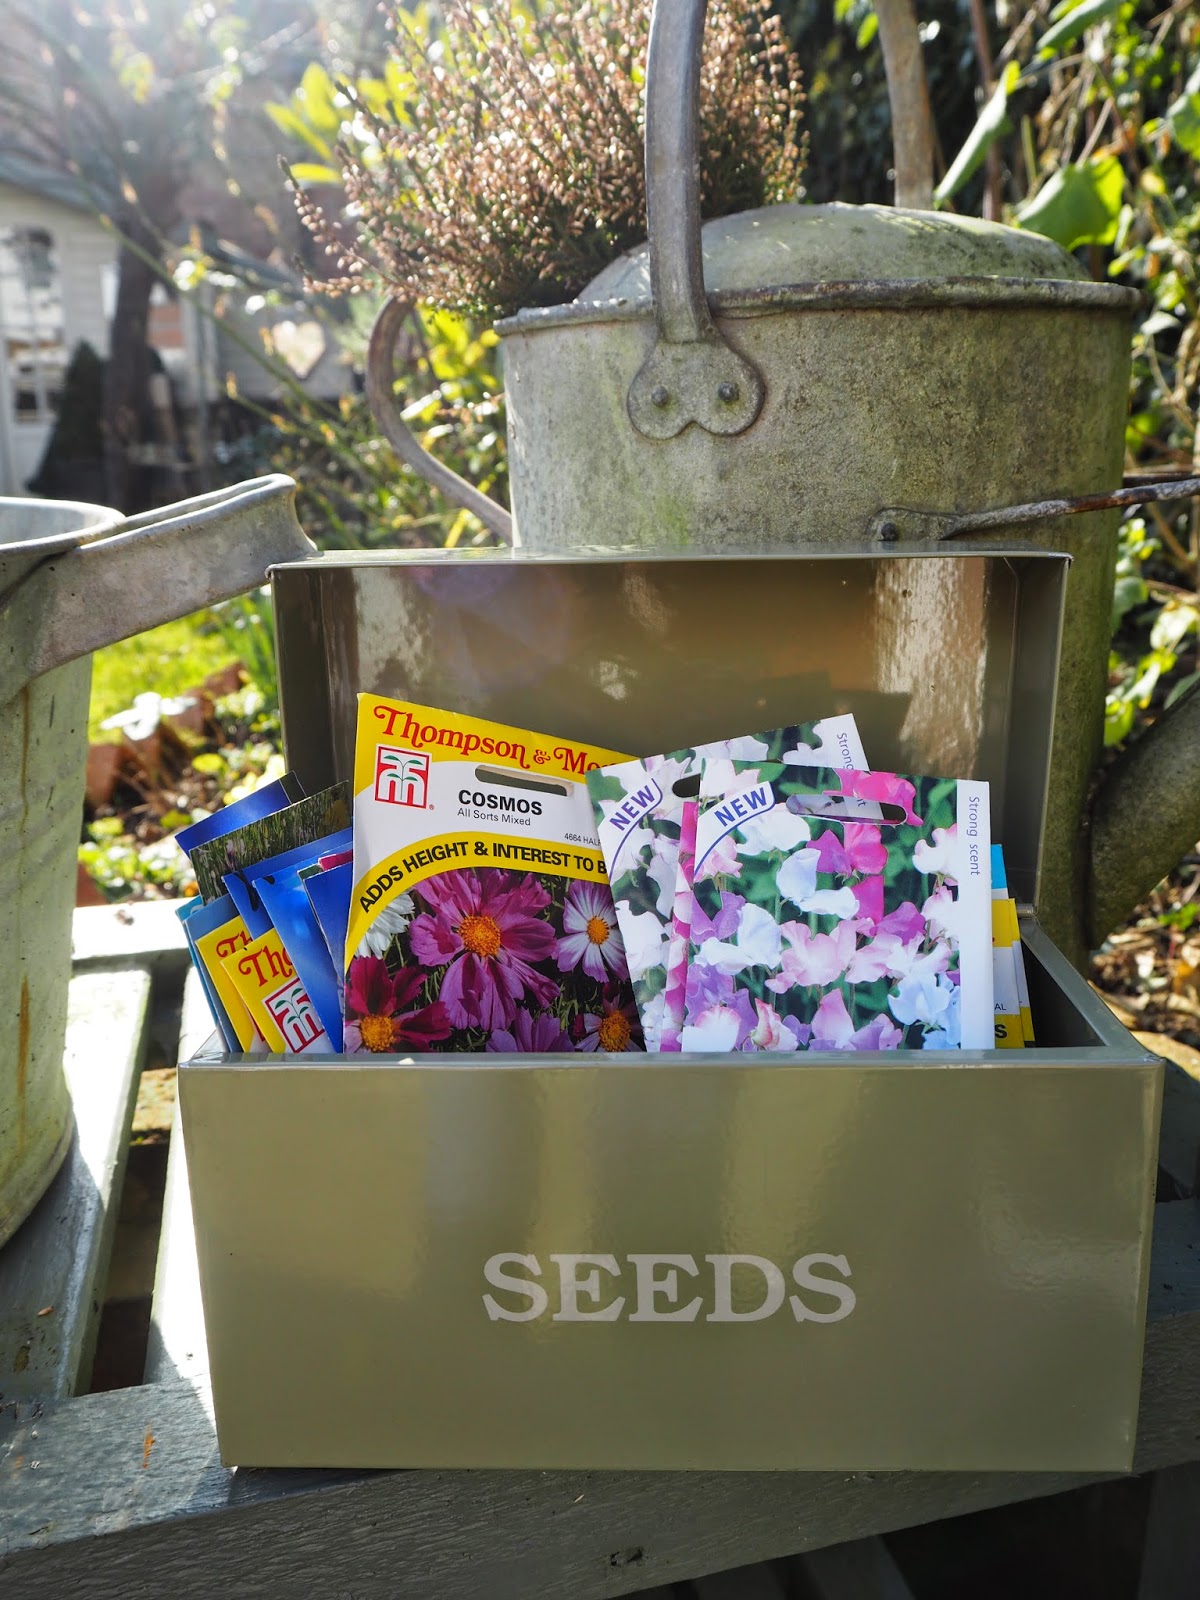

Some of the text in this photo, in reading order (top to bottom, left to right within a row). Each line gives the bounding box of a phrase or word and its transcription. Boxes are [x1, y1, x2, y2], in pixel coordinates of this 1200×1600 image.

[373, 705, 616, 775] Thompson & Mo
[457, 807, 531, 826] All Sorts Mixed
[458, 789, 543, 816] COSMOS
[609, 784, 654, 831] NEW
[714, 786, 768, 827] NEW
[564, 832, 581, 843] 4664
[967, 796, 980, 876] Strong scent
[359, 865, 404, 913] ADDS
[402, 841, 469, 874] HEIGHT
[473, 841, 489, 856] &
[492, 844, 571, 867] INTEREST
[573, 856, 594, 872] TO
[482, 1252, 857, 1323] SEEDS
